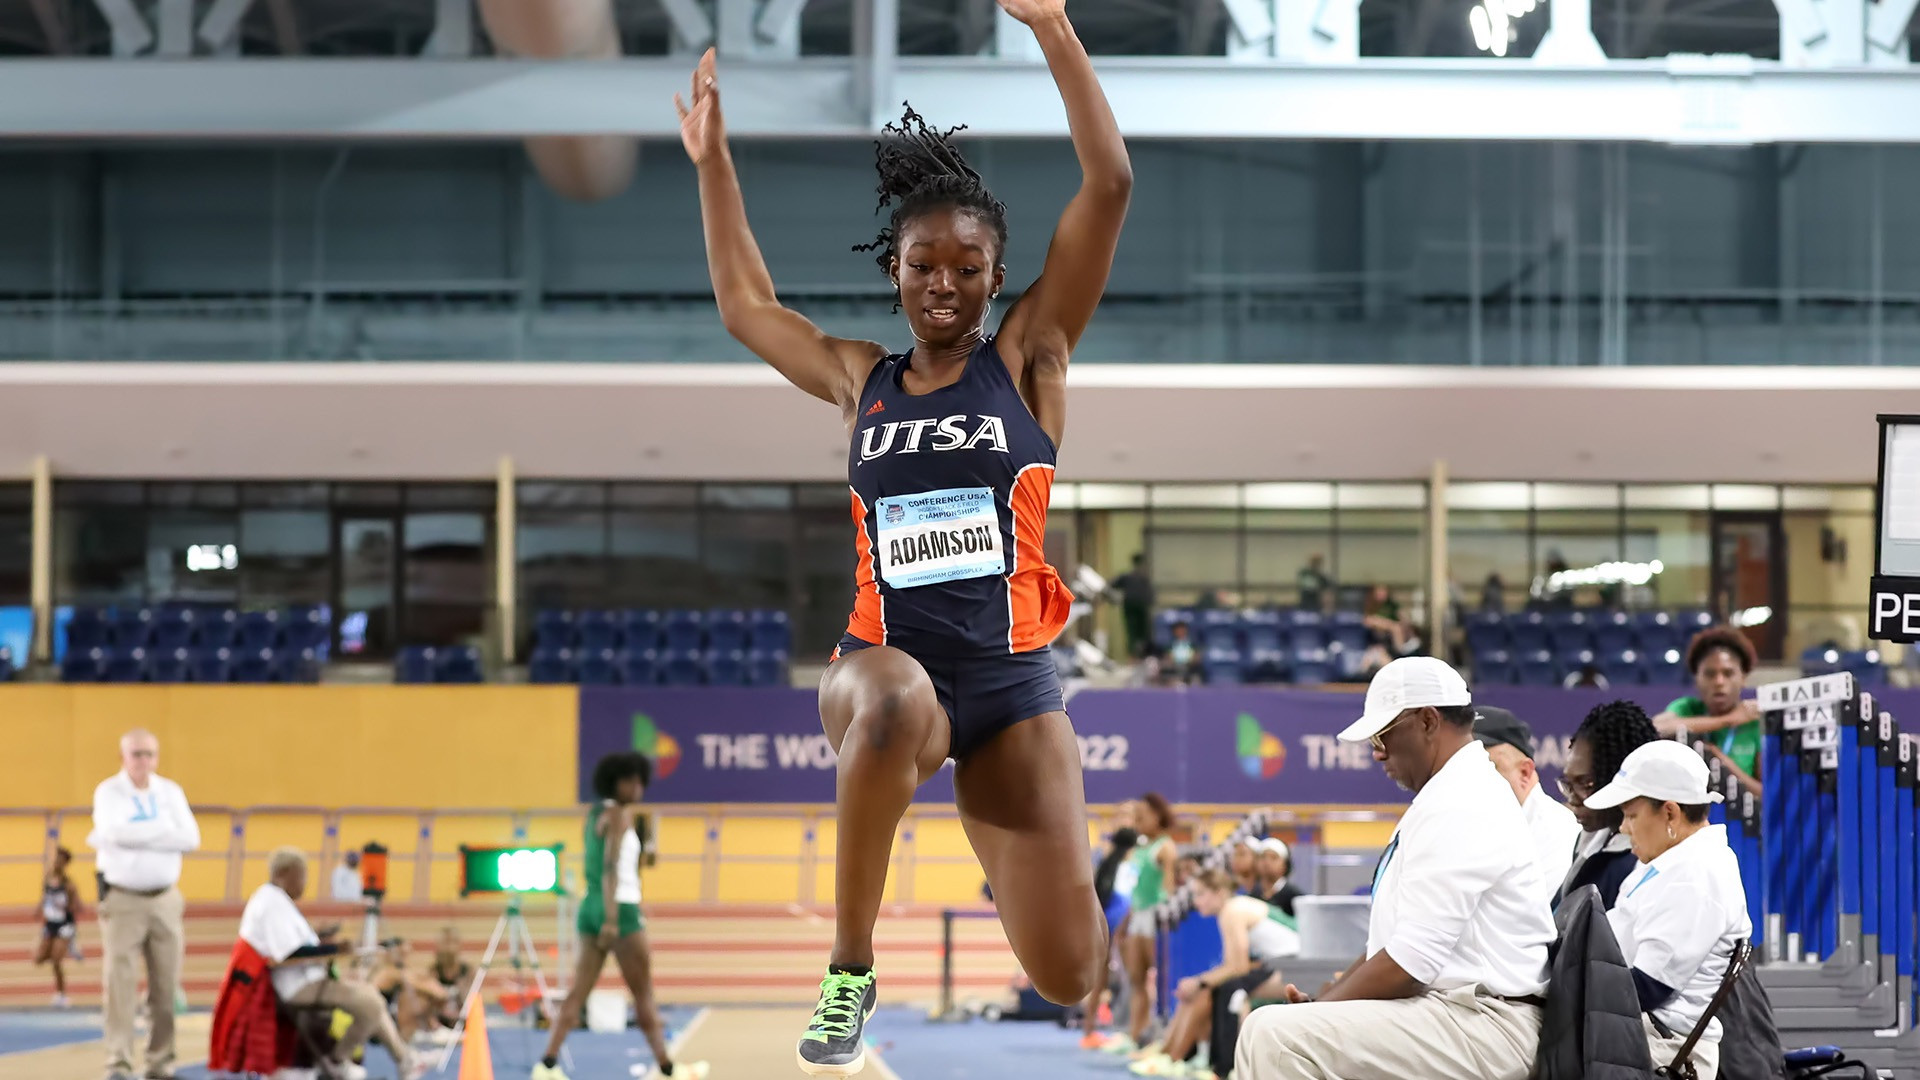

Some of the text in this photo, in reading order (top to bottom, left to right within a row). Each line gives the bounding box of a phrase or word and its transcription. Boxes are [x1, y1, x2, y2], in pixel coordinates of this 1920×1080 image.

[857, 414, 1009, 467] UTSA
[908, 494, 965, 507] CONFERENCE
[890, 525, 993, 567] ADAMSON
[907, 567, 983, 583] BIRMINGHAM CROSSPLEX
[696, 733, 769, 769] THE
[1301, 733, 1371, 770] THE
